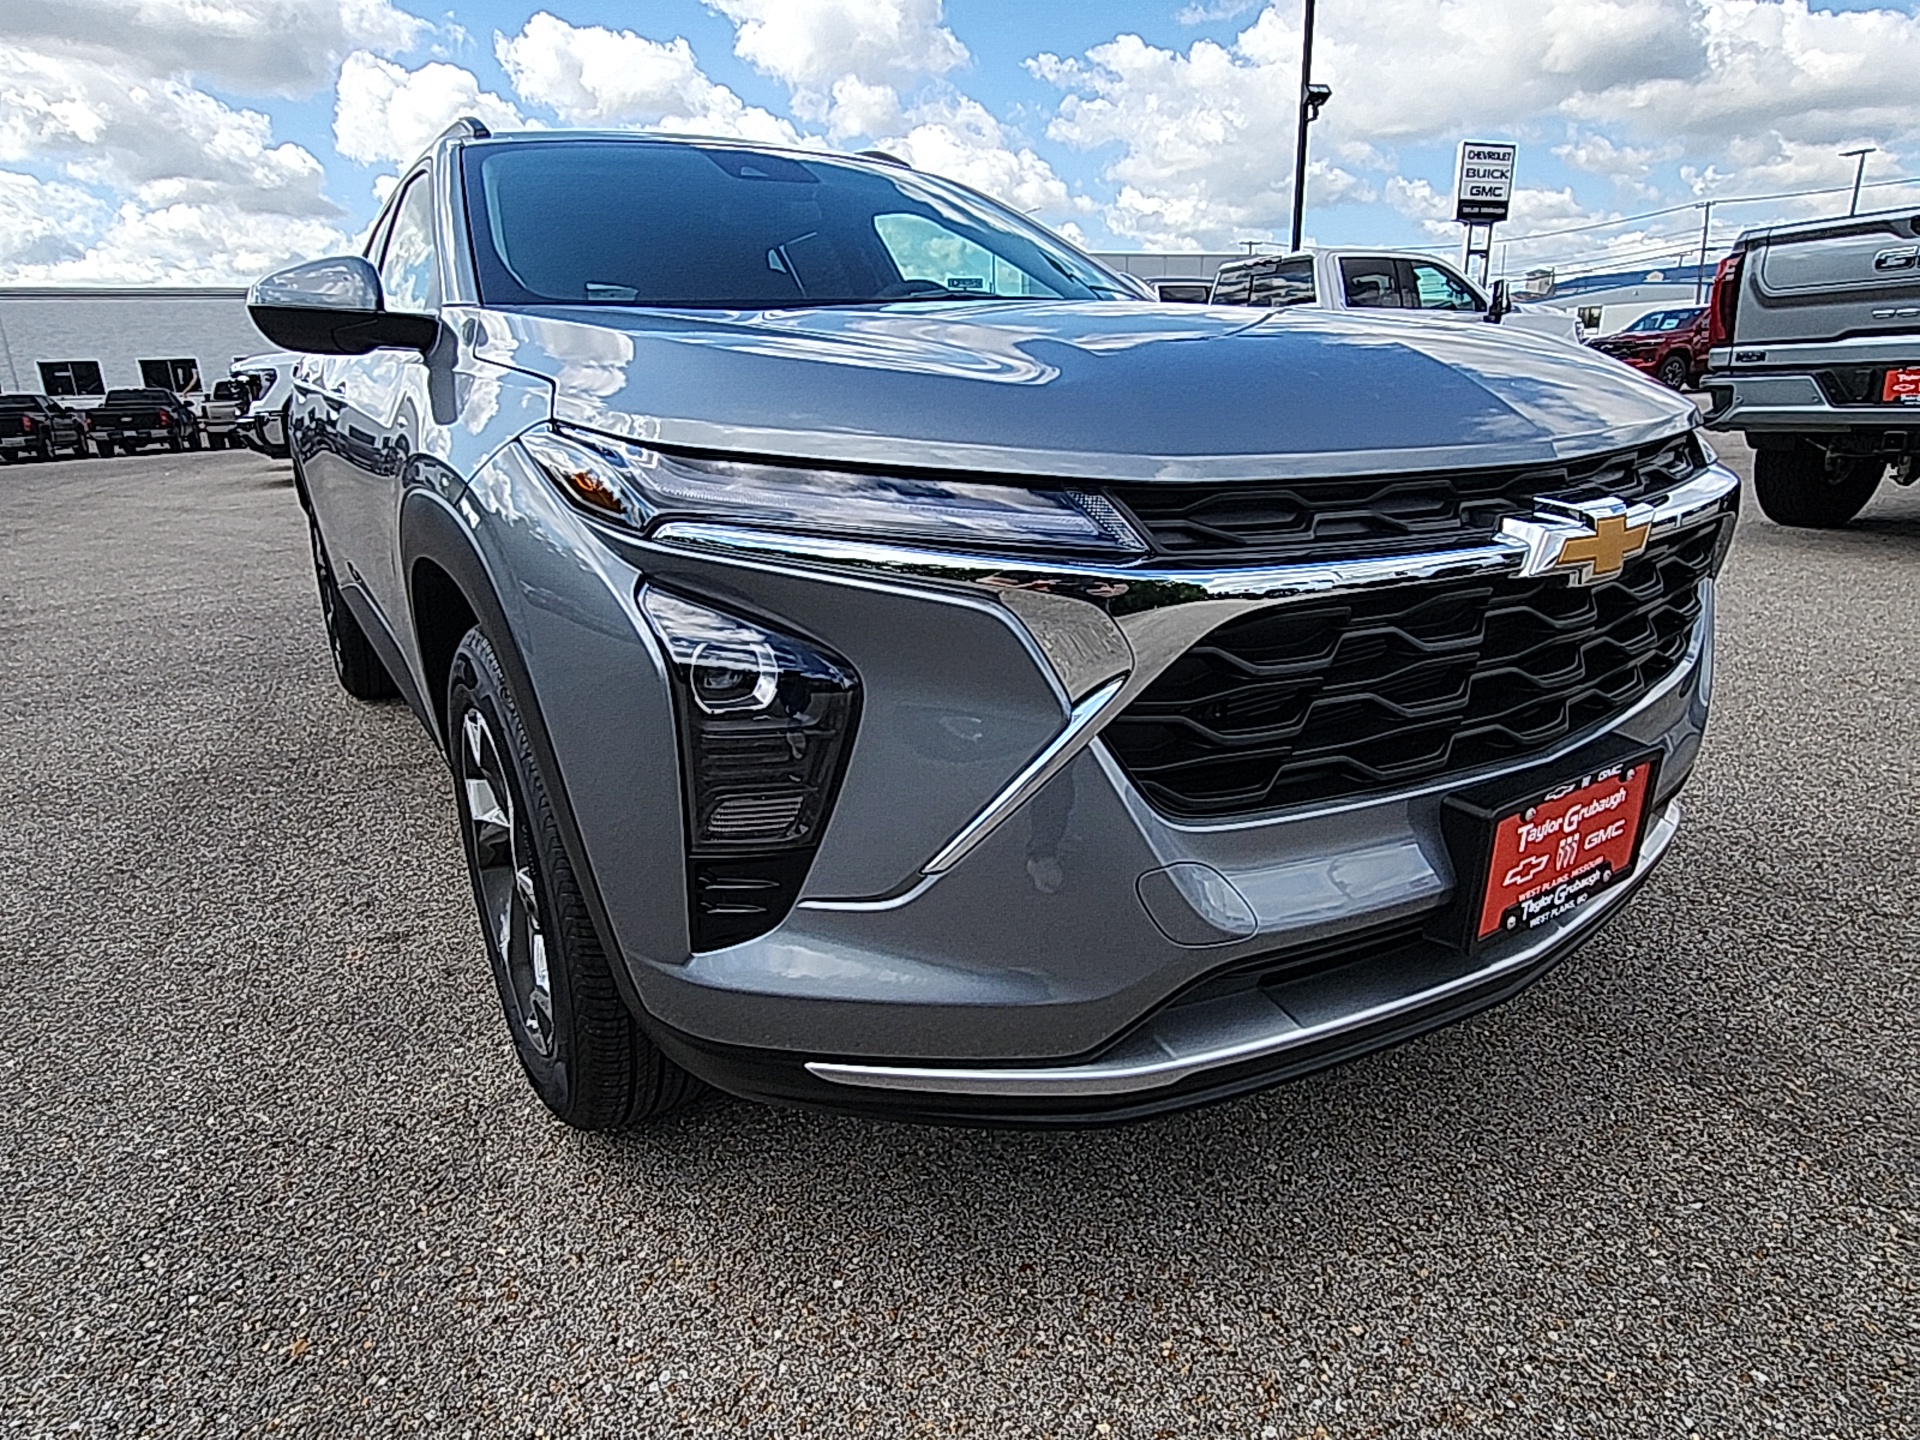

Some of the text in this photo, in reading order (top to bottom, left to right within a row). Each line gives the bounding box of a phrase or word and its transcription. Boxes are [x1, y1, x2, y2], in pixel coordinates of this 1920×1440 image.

[1467, 150, 1512, 161] CHEVROLET
[1465, 168, 1510, 179] BUICK
[1469, 186, 1503, 197] GMC
[1517, 787, 1626, 853] Taylor Grubaugh
[1583, 820, 1626, 850] GMC
